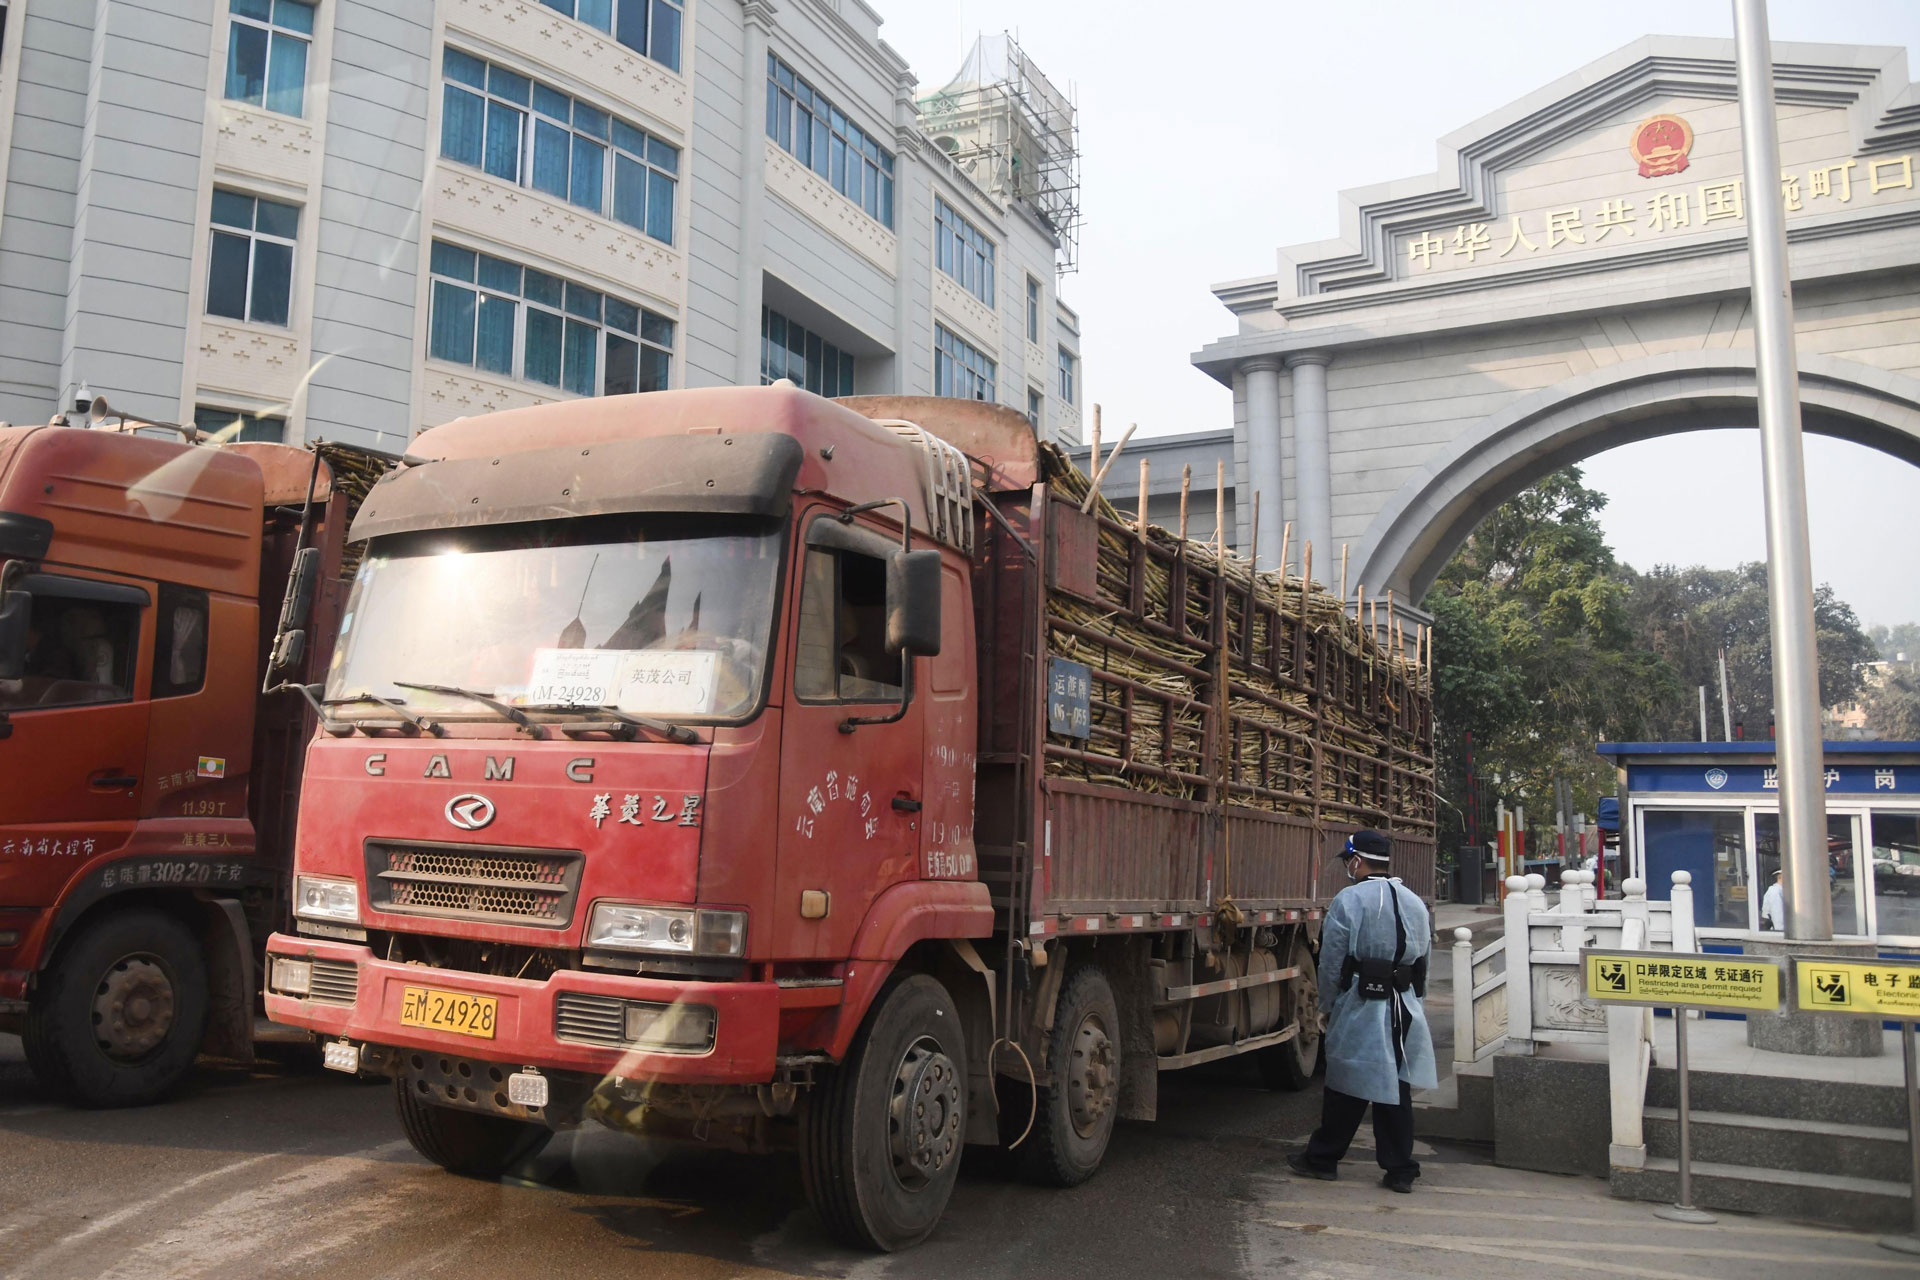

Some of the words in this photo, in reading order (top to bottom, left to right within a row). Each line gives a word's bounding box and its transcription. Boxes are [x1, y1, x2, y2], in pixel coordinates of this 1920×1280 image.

[631, 669, 693, 687] 英茂公司
[364, 753, 595, 783] CAMC
[2, 838, 97, 857] 云南省大理市
[1636, 964, 1707, 981] 口岸限定区域
[1714, 967, 1764, 984] 凭证通行
[1638, 978, 1679, 988] Restricted
[1681, 982, 1700, 990] area
[1702, 983, 1728, 992] permit
